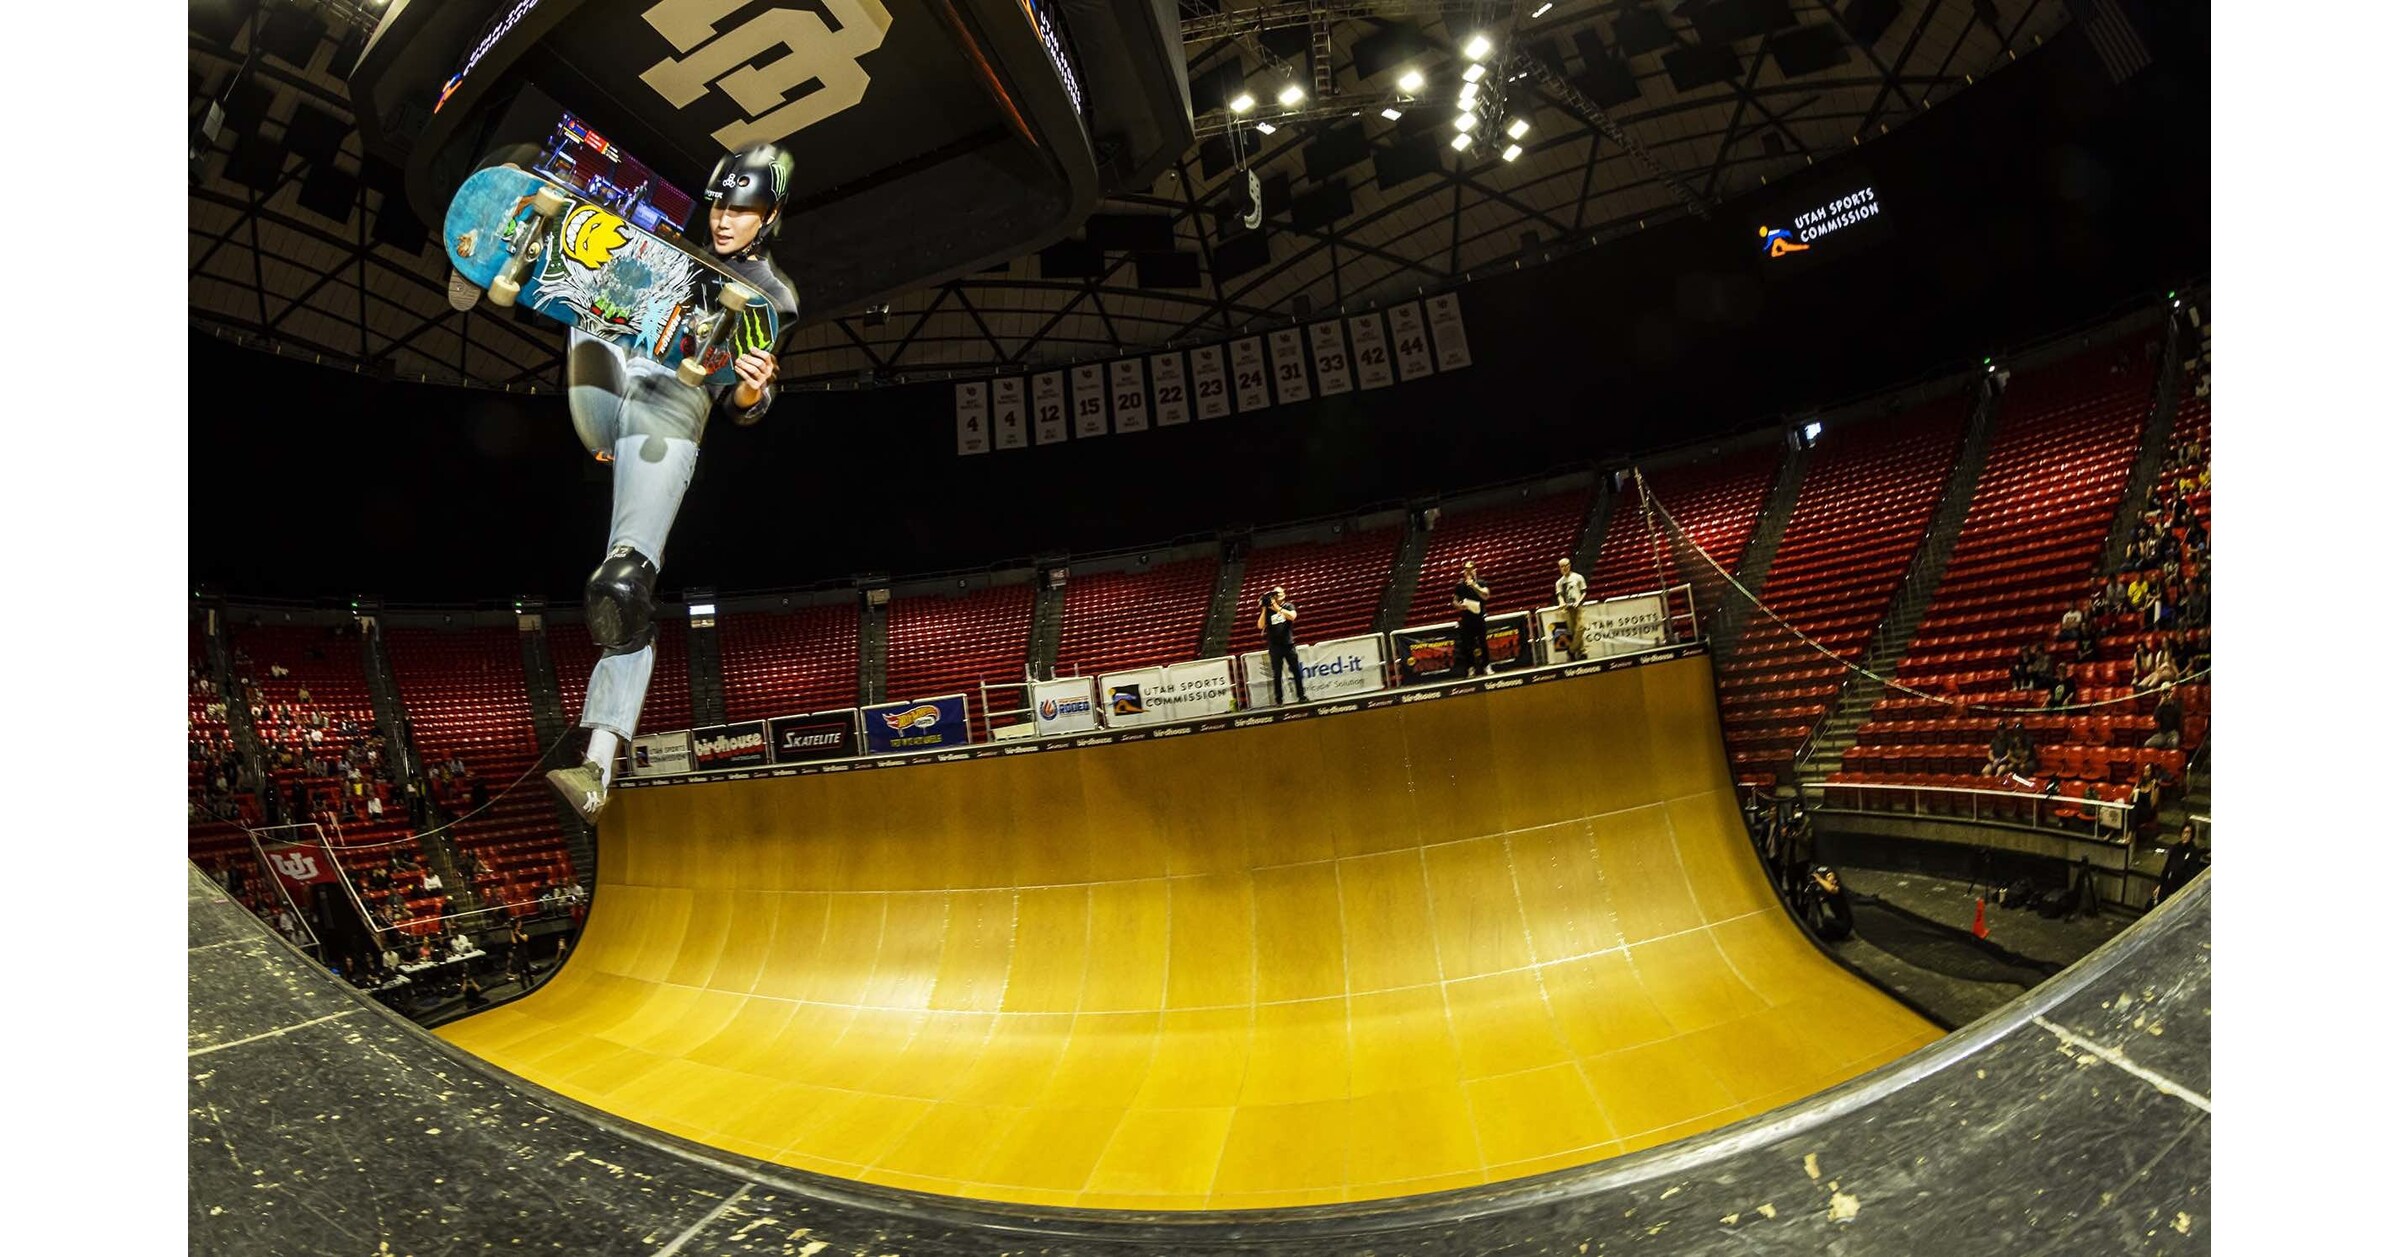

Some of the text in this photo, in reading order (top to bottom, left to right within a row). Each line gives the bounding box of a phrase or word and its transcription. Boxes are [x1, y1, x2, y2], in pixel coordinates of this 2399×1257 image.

[463, 0, 539, 77] COMMISSIO
[1040, 10, 1081, 103] UTAH SPORTS
[1040, 25, 1081, 115] COMMISSION
[1794, 186, 1875, 230] UTAH SPORTS
[1800, 200, 1880, 243] COMMISSION
[1360, 346, 1385, 366] 42
[1400, 336, 1423, 356] 44
[1280, 362, 1302, 381] 31
[1319, 353, 1345, 373] 33
[1199, 378, 1223, 399] 23
[1238, 369, 1262, 389] 24
[1118, 391, 1142, 411] 20
[1159, 385, 1183, 405] 22
[1040, 404, 1060, 423] 12
[1079, 397, 1100, 416] 15
[966, 416, 979, 432] 4
[1004, 410, 1016, 428] 4
[1618, 612, 1659, 627] SPORTS
[1585, 624, 1659, 643] COMMISSION
[1288, 655, 1363, 681] hred-it
[1143, 676, 1226, 697] UTAH SPORTS
[1145, 688, 1228, 708] COMMISSION
[693, 731, 762, 757] birdhouse
